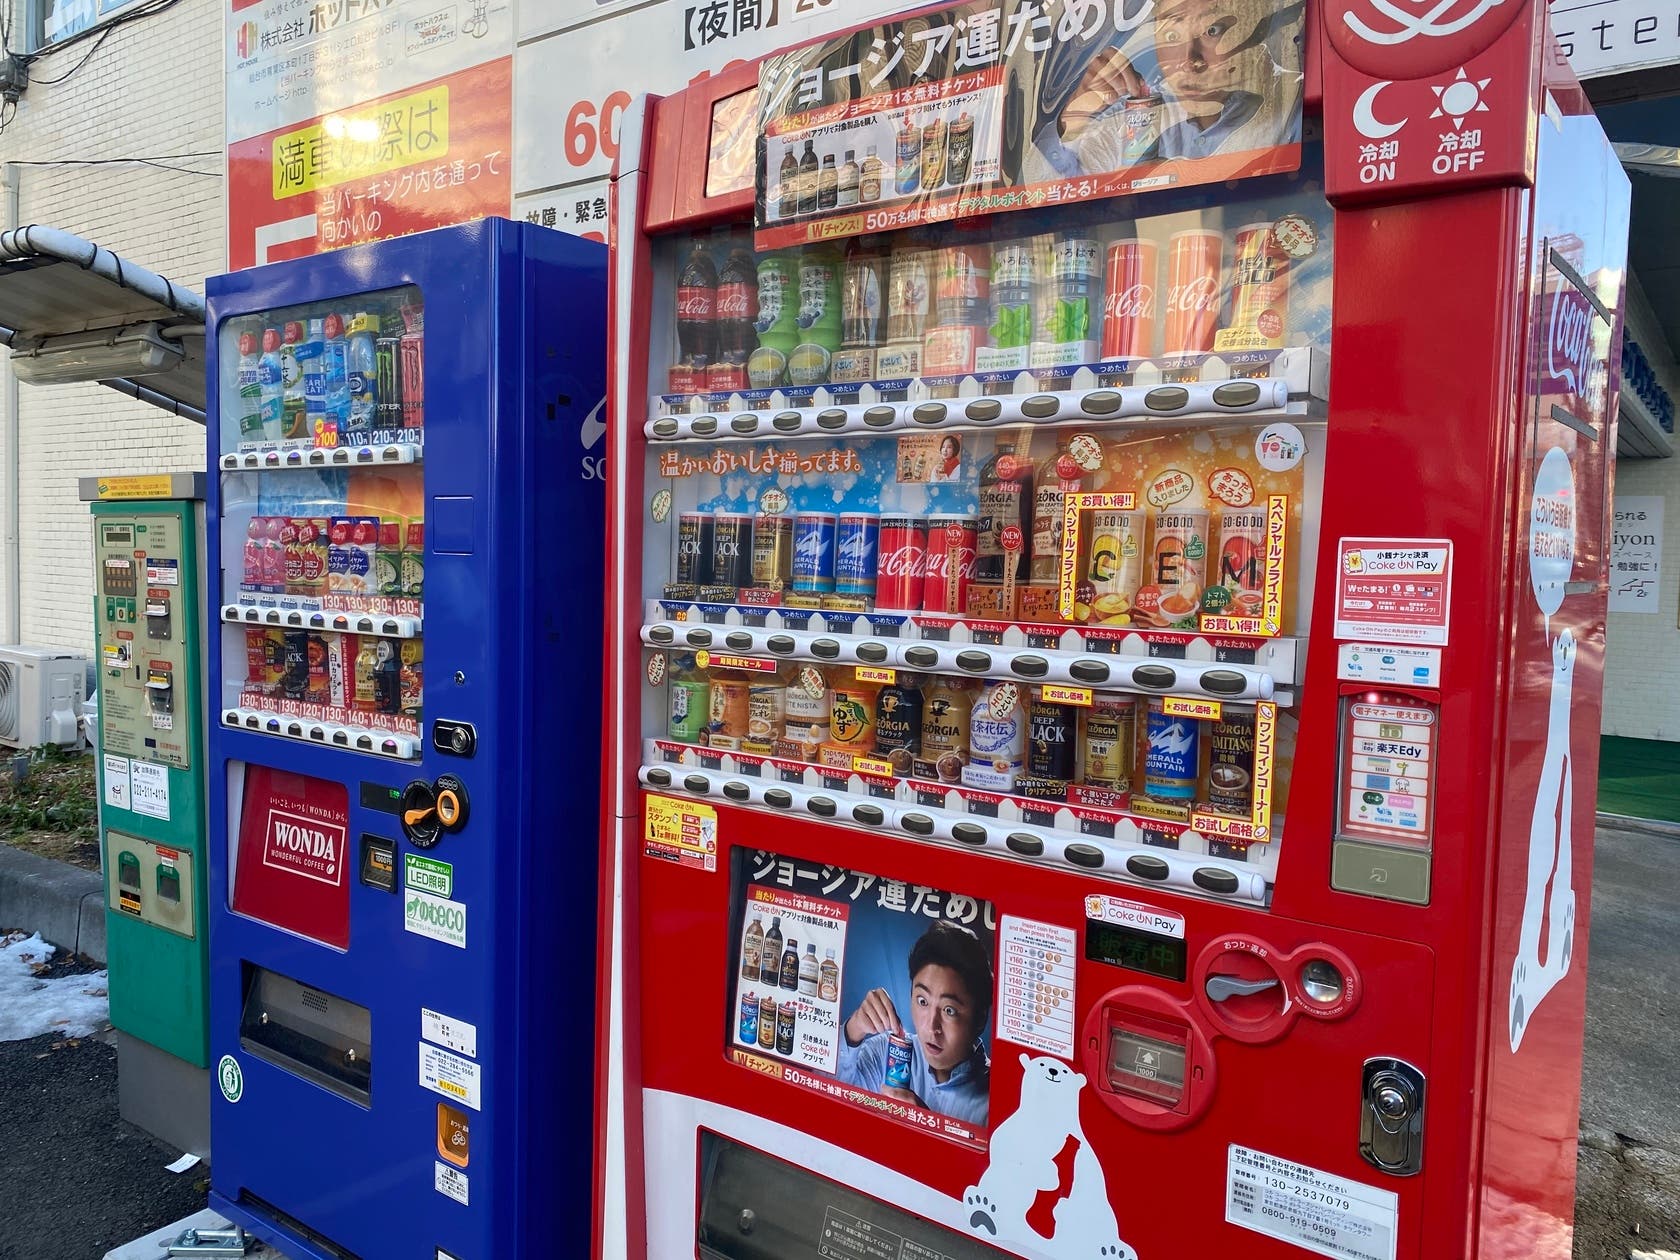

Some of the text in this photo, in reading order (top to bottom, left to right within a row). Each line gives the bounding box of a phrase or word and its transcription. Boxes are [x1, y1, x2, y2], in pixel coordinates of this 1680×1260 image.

[684, 0, 779, 51] 【夜間】
[261, 17, 304, 49] 株式会社
[1438, 129, 1481, 153] 冷却
[1359, 141, 1398, 164] 冷却
[1432, 151, 1485, 175] OFF
[1359, 162, 1396, 184] ON
[320, 151, 502, 218] 当パーキング内を通って
[321, 211, 382, 246] 向かいの
[811, 218, 862, 239] Wチャンス!
[1164, 359, 1198, 368] つめたい
[1232, 353, 1268, 364] つめたい
[1039, 369, 1069, 378] つめたい
[1099, 364, 1131, 374] つめたい
[930, 377, 956, 387] つめたい
[982, 373, 1011, 382] つめたい
[832, 384, 855, 394] つめたい
[879, 380, 904, 390] つめたい
[707, 392, 728, 401] つめたい
[745, 390, 768, 399] つめたい
[788, 388, 811, 397] つめたい
[316, 431, 337, 447] ¥100
[661, 447, 862, 477] 温かいおいしさ揃ってます。
[1154, 474, 1184, 494] 新商品
[1154, 484, 1190, 504] 入りました
[1081, 494, 1132, 507] お買い得!!
[1614, 511, 1647, 521] られる
[947, 529, 961, 538] NEW
[1003, 531, 1019, 540] NEW
[1613, 530, 1656, 551] iyon
[1376, 551, 1429, 560] 小銭ナシで決済
[1613, 551, 1653, 559] スペース
[1158, 552, 1180, 585] E
[1222, 556, 1257, 586] M
[1368, 560, 1396, 570] Coke
[1416, 560, 1438, 572] Pay
[1348, 584, 1388, 594] Wでたまる!
[1636, 588, 1648, 598] 2F
[1206, 591, 1226, 599] トマト
[667, 603, 685, 611] つめたい
[784, 611, 806, 619] つめたい
[828, 614, 851, 622] つめたい
[874, 617, 898, 625] つめたい
[919, 620, 949, 629] あたたかい
[1204, 617, 1261, 632] お買い得!!
[971, 623, 1003, 632] あたたかい
[1025, 627, 1060, 636] あたたかい
[1084, 630, 1121, 640] あたたかい
[1148, 635, 1186, 644] あたたかい
[1214, 639, 1256, 649] あたたかい
[720, 657, 762, 668] 期間限定セール
[861, 671, 889, 681] お試し価格
[991, 688, 1007, 708] HOT
[1050, 690, 1084, 701] お試し価格
[1172, 703, 1212, 716] お試し価格
[1355, 706, 1429, 721] 電子マネー使えます
[833, 707, 852, 735] ゆず
[1034, 717, 1055, 726] DEEP
[661, 744, 683, 752] あたたかい
[1376, 742, 1422, 759] 楽天Edy
[697, 749, 721, 759] あたたかい
[735, 756, 760, 765] あたたかい
[776, 762, 803, 772] あたたかい
[859, 761, 886, 772] お試し価格
[820, 769, 848, 778] あたたかい
[1257, 721, 1271, 824] ワンコインコーナー
[865, 776, 894, 786] あたたかい
[915, 784, 944, 795] あたたかい
[965, 792, 998, 803] あたたかい
[1080, 796, 1115, 808] 飲みごたえ
[1020, 801, 1054, 813] あたたかい
[647, 813, 672, 824] スタンプ
[1078, 811, 1114, 823] あたたかい
[1140, 822, 1179, 834] あたたかい
[1194, 815, 1254, 837] お試し価格
[275, 821, 336, 862] WONDA
[271, 849, 325, 871] WONDERFUL COFFEE
[411, 870, 446, 892] LED照明
[752, 903, 771, 914] Coke
[420, 901, 464, 934] のむeco
[1108, 908, 1135, 922] Coke
[1154, 918, 1176, 933] Pay
[1019, 927, 1031, 935] then
[1031, 930, 1045, 938] press
[1010, 944, 1024, 953] ¥170
[1223, 941, 1268, 957] おつり・返却
[1009, 956, 1023, 965] ¥160
[1009, 967, 1023, 975] ¥150
[1008, 976, 1023, 986] ¥140
[1008, 987, 1022, 996] ¥130
[1008, 997, 1022, 1007] ¥120
[1007, 1008, 1022, 1018] ¥110
[797, 1011, 838, 1030] もう1チャンス!
[1007, 1018, 1021, 1028] ¥100
[802, 1033, 829, 1047] 引き換えは
[1020, 1031, 1035, 1041] forget
[1035, 1036, 1048, 1044] your
[800, 1042, 819, 1054] Coke
[737, 1052, 780, 1076] Wチャンス!
[802, 1053, 826, 1066] アプリで。
[1138, 1068, 1155, 1079] 1000
[1235, 1148, 1315, 1178] 故障・お問い合わせの連絡先
[1235, 1154, 1347, 1194] 下記管理番号と内容をお知らせください
[1264, 1176, 1350, 1210] 130-2537079
[1261, 1206, 1337, 1237] 0800-919-0509
